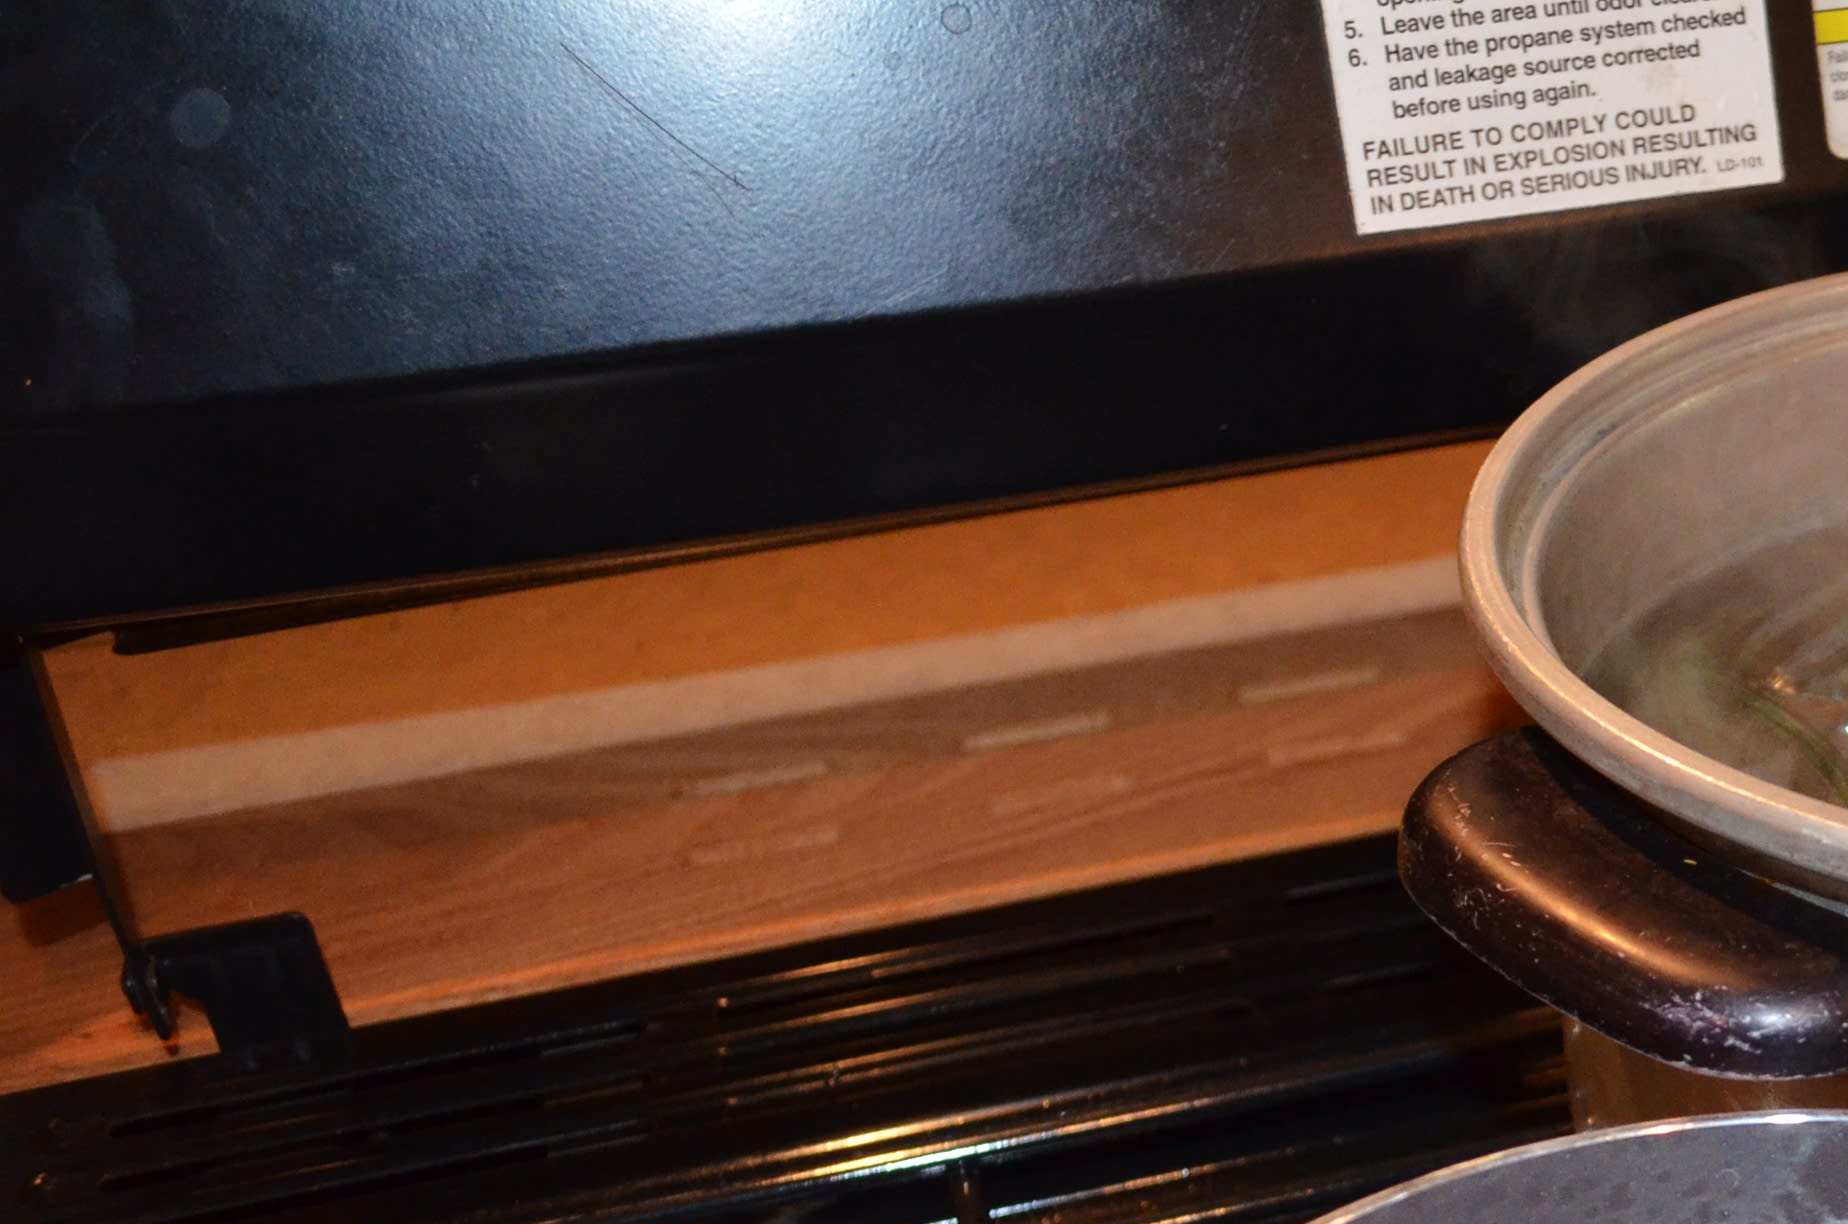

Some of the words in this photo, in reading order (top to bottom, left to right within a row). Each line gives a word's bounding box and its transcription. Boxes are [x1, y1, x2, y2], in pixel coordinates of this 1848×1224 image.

[1344, 20, 1363, 39] 5.
[1381, 14, 1445, 35] Leave
[1451, 8, 1485, 27] the
[1491, 5, 1537, 23] area
[1543, 0, 1589, 17] until
[1349, 49, 1367, 67] 6.
[1385, 44, 1439, 63] Have
[1445, 38, 1479, 57] the
[1486, 28, 1573, 57] propane
[1580, 20, 1655, 45] system
[1662, 7, 1746, 32] checked
[1389, 73, 1427, 91] and
[1435, 63, 1517, 86] leakage
[1524, 54, 1595, 75] source
[1602, 40, 1700, 67] corrected
[1393, 97, 1461, 119] before
[1468, 90, 1526, 111] using
[1533, 81, 1595, 105] again.
[1363, 131, 1464, 160] FAILURE
[1471, 127, 1502, 147] TO
[1511, 113, 1607, 143] COMPLY
[1615, 104, 1696, 130] COULD
[1367, 160, 1456, 187] RESULT
[1464, 156, 1486, 175] IN
[1494, 139, 1625, 172] EXPLOSION
[1633, 124, 1756, 154] RESULTING
[1371, 195, 1394, 214] IN
[1401, 185, 1475, 210] DEATH
[1482, 180, 1514, 200] OR
[1520, 166, 1620, 196] SERIOUS
[1626, 156, 1706, 181] INJURY.
[1717, 156, 1763, 172] LD-101
